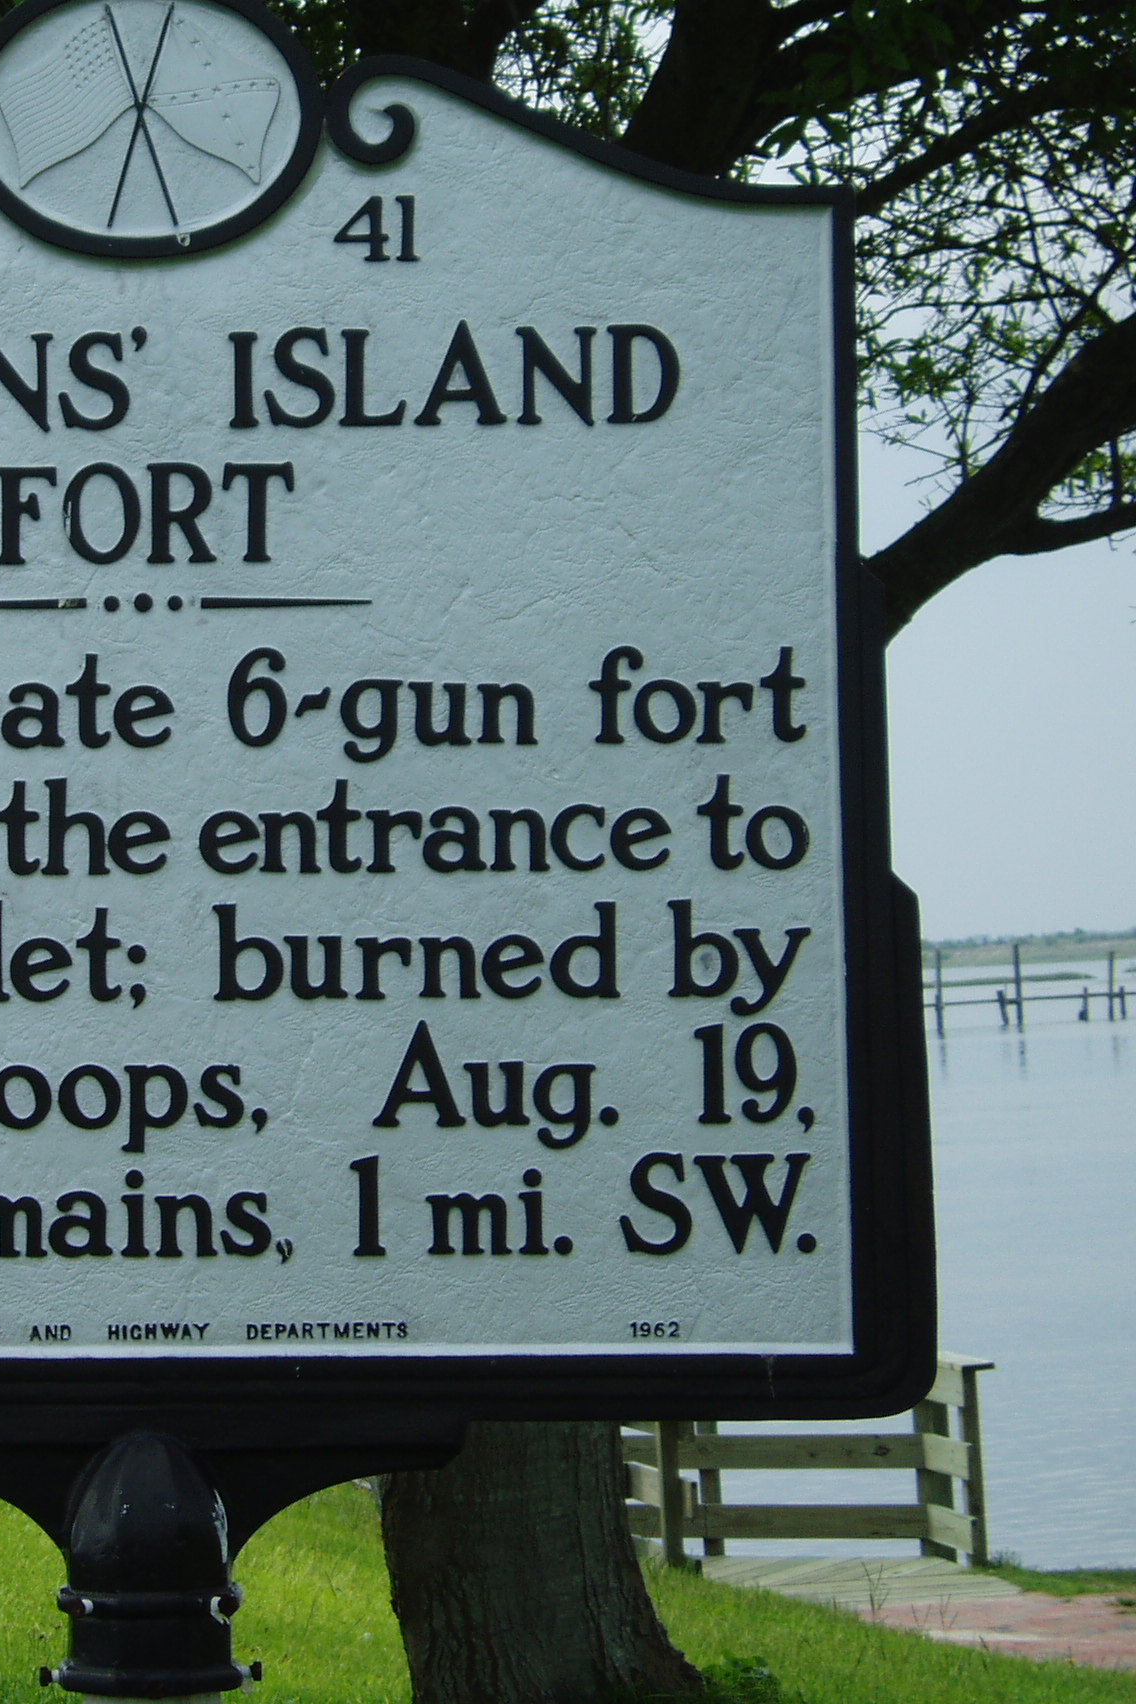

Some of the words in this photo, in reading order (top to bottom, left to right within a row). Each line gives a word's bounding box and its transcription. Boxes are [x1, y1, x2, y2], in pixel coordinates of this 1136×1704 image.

[332, 194, 421, 265] 41
[227, 319, 681, 432] ISLAND
[226, 647, 539, 766] 6-gun
[587, 645, 808, 747] fort
[197, 773, 673, 877] entrance
[695, 773, 811, 875] to
[211, 898, 622, 1004] burned
[666, 898, 813, 1021] by
[371, 1019, 620, 1153] Aug.
[692, 1021, 820, 1135] 19,
[348, 1154, 388, 1262] 1
[423, 1167, 574, 1260] mi.
[615, 1151, 818, 1261] SW.
[28, 1323, 72, 1343] AND
[107, 1322, 211, 1343] HIGHWAY
[245, 1320, 410, 1343] DEPARTMENTS
[628, 1320, 681, 1340] 1962
